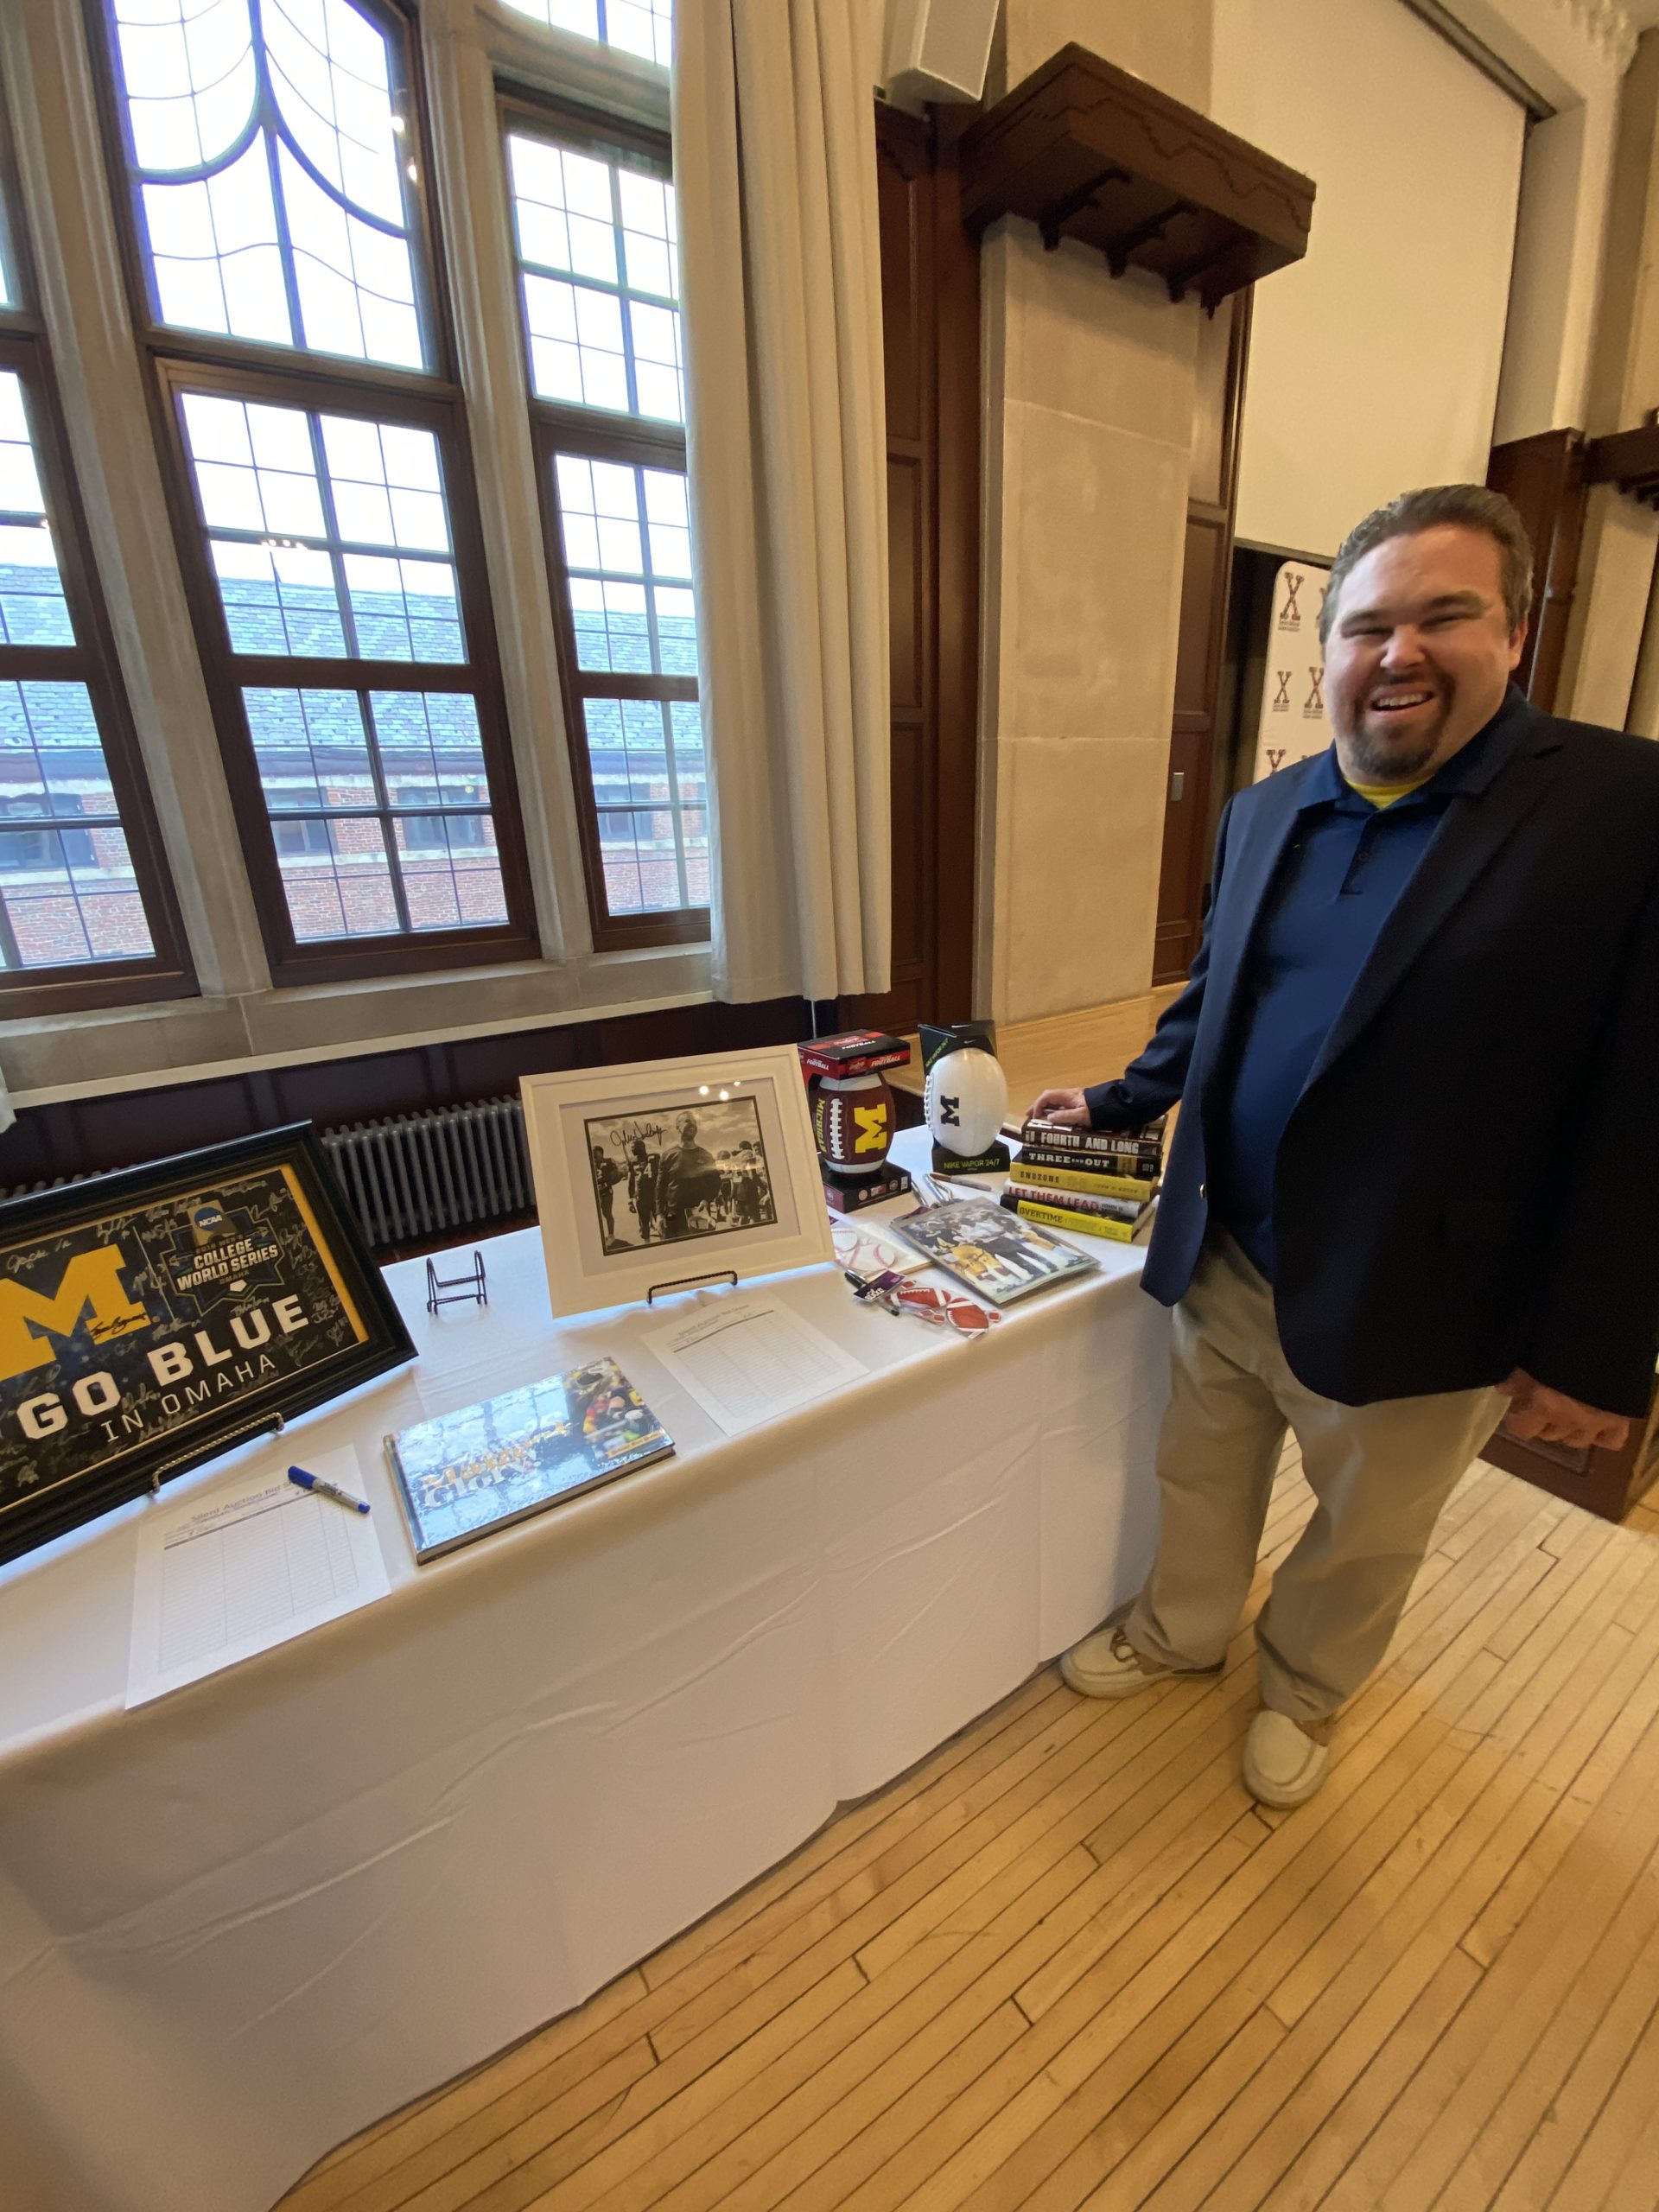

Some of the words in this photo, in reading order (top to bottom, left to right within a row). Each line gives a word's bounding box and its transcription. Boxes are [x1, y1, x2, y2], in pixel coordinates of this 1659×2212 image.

[807, 1058, 830, 1071] FOOTBALL
[870, 1055, 901, 1067] FOOTBALL
[940, 1095, 960, 1127] M
[816, 1098, 827, 1153] MICHIGAN
[854, 1102, 887, 1154] M
[1040, 1132, 1081, 1147] FOURTH
[1084, 1136, 1108, 1151] AND
[1111, 1140, 1139, 1154] LONG
[962, 1160, 984, 1168] VAPOR
[985, 1158, 1001, 1167] 24/7
[1028, 1153, 1071, 1164] THREE
[1084, 1158, 1110, 1167] OUT
[1020, 1170, 1060, 1184] ENDZONE
[1008, 1186, 1027, 1198] LET
[1030, 1190, 1065, 1205] THEM
[1067, 1197, 1100, 1211] LEAD
[198, 1215, 223, 1228] NCAA
[1020, 1206, 1063, 1224] OVERTIME
[194, 1238, 254, 1269] COLLEGE
[176, 1262, 229, 1291] WORLD
[230, 1244, 278, 1272] SERIES
[219, 1269, 250, 1285] OMAHA
[0, 1243, 152, 1382] M
[16, 1370, 121, 1440] GO
[147, 1294, 309, 1387] BLUE
[101, 1409, 144, 1443] IN
[162, 1354, 276, 1414] OMAHA
